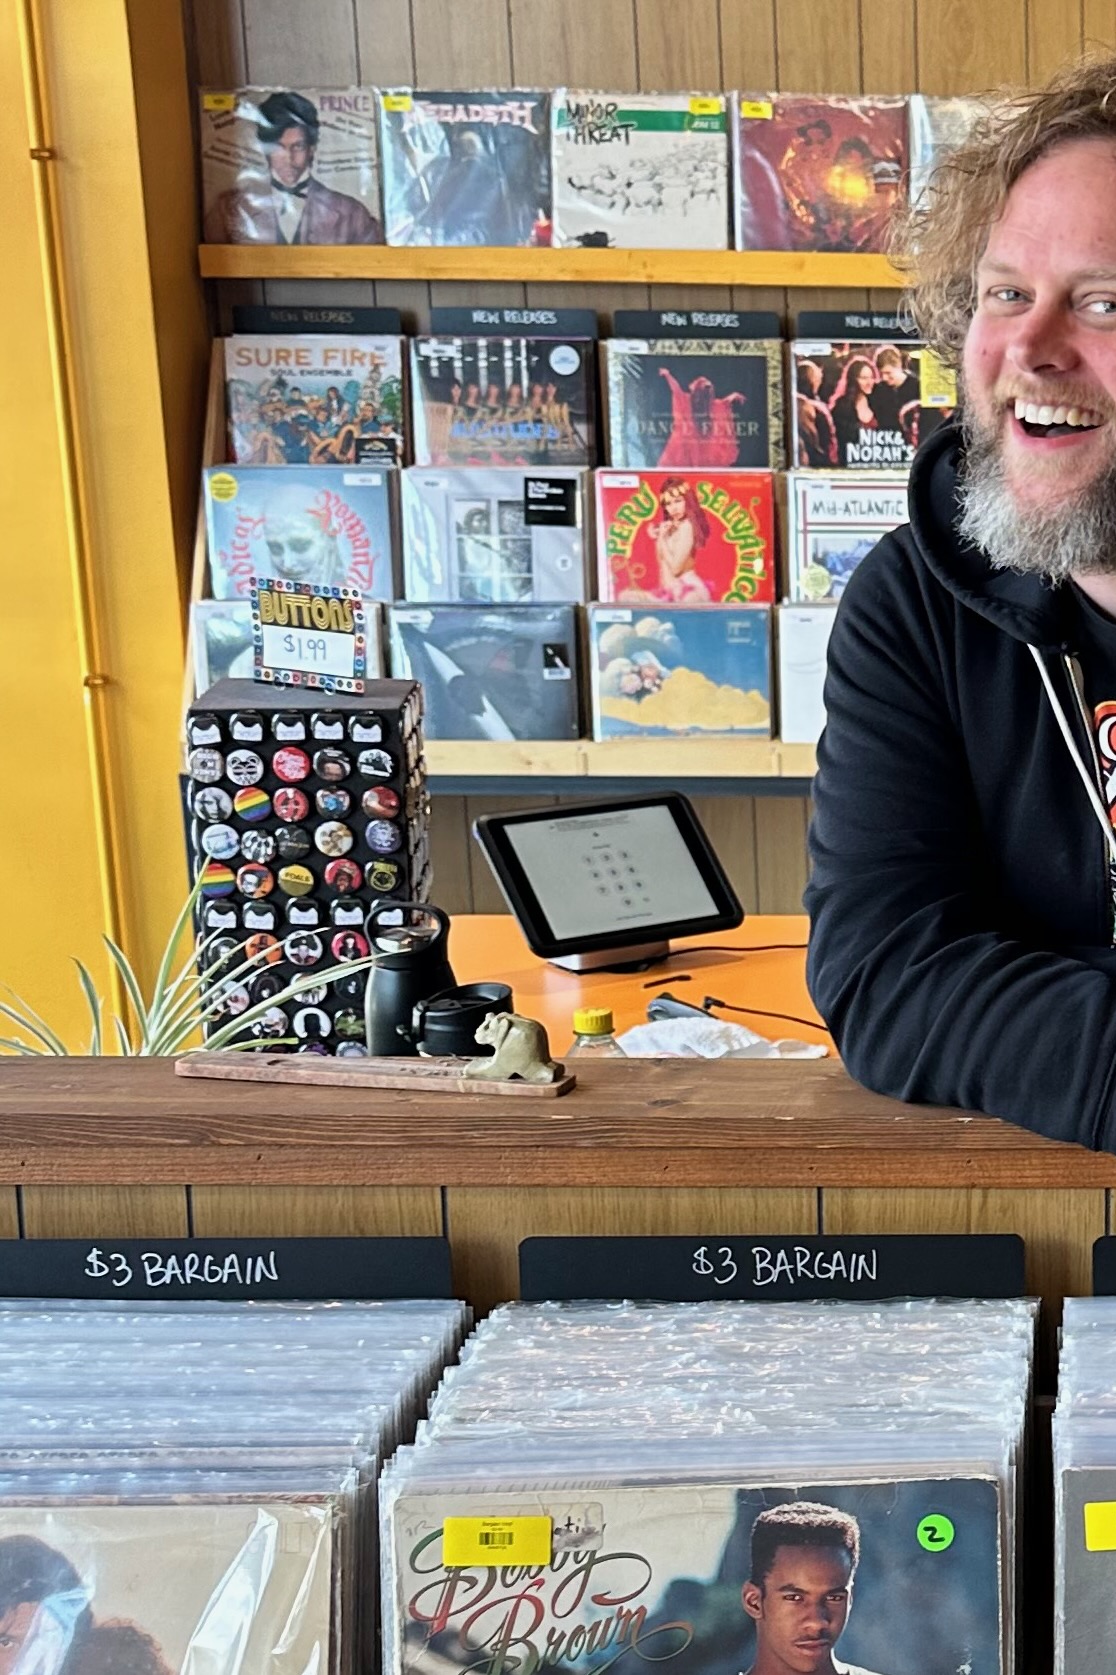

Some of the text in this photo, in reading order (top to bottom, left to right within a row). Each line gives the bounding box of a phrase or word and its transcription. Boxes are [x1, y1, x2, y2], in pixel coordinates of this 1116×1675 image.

[319, 95, 369, 112] PRINCE
[472, 310, 557, 324] NEW RELEASES
[661, 312, 740, 327] NEW RELEASES
[845, 315, 870, 328] NEW
[235, 347, 388, 367] SURE FIRE
[846, 442, 917, 463] NORAH'S
[259, 590, 354, 632] BUTTONS
[284, 634, 327, 661] $1.99
[84, 1247, 279, 1286] $3 BARGAIN
[691, 1246, 877, 1285] $3 BARGAIN
[921, 1523, 947, 1543] 2
[455, 1577, 694, 1675] Brown
